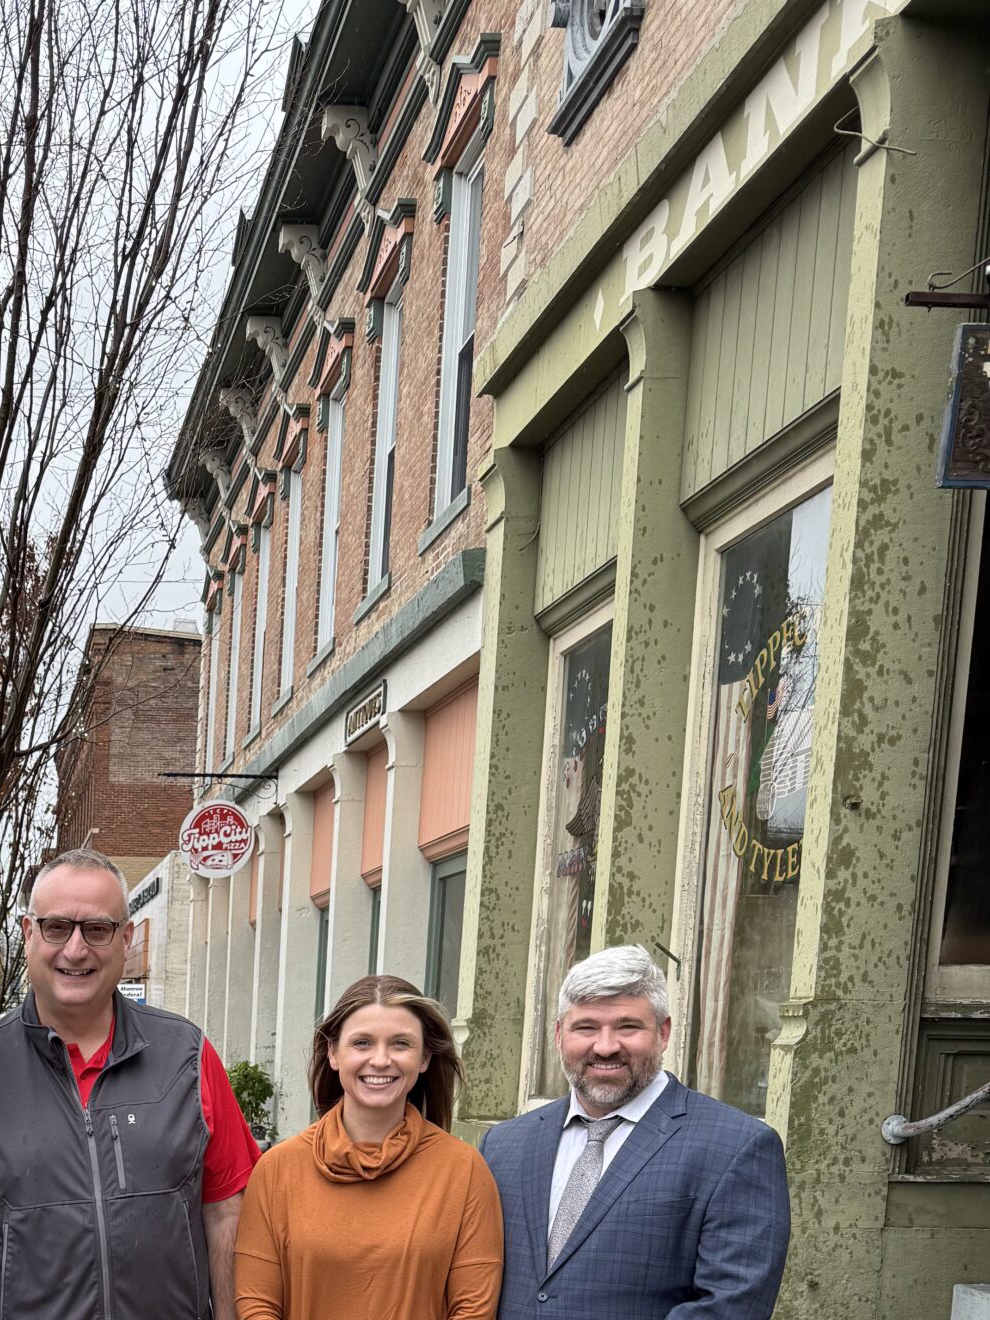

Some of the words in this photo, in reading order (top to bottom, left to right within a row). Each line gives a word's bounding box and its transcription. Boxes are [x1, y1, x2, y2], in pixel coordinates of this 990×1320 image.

[181, 827, 220, 853] Tipp
[219, 825, 251, 844] City
[223, 842, 246, 850] PIZZA
[749, 838, 803, 882] TYLE
